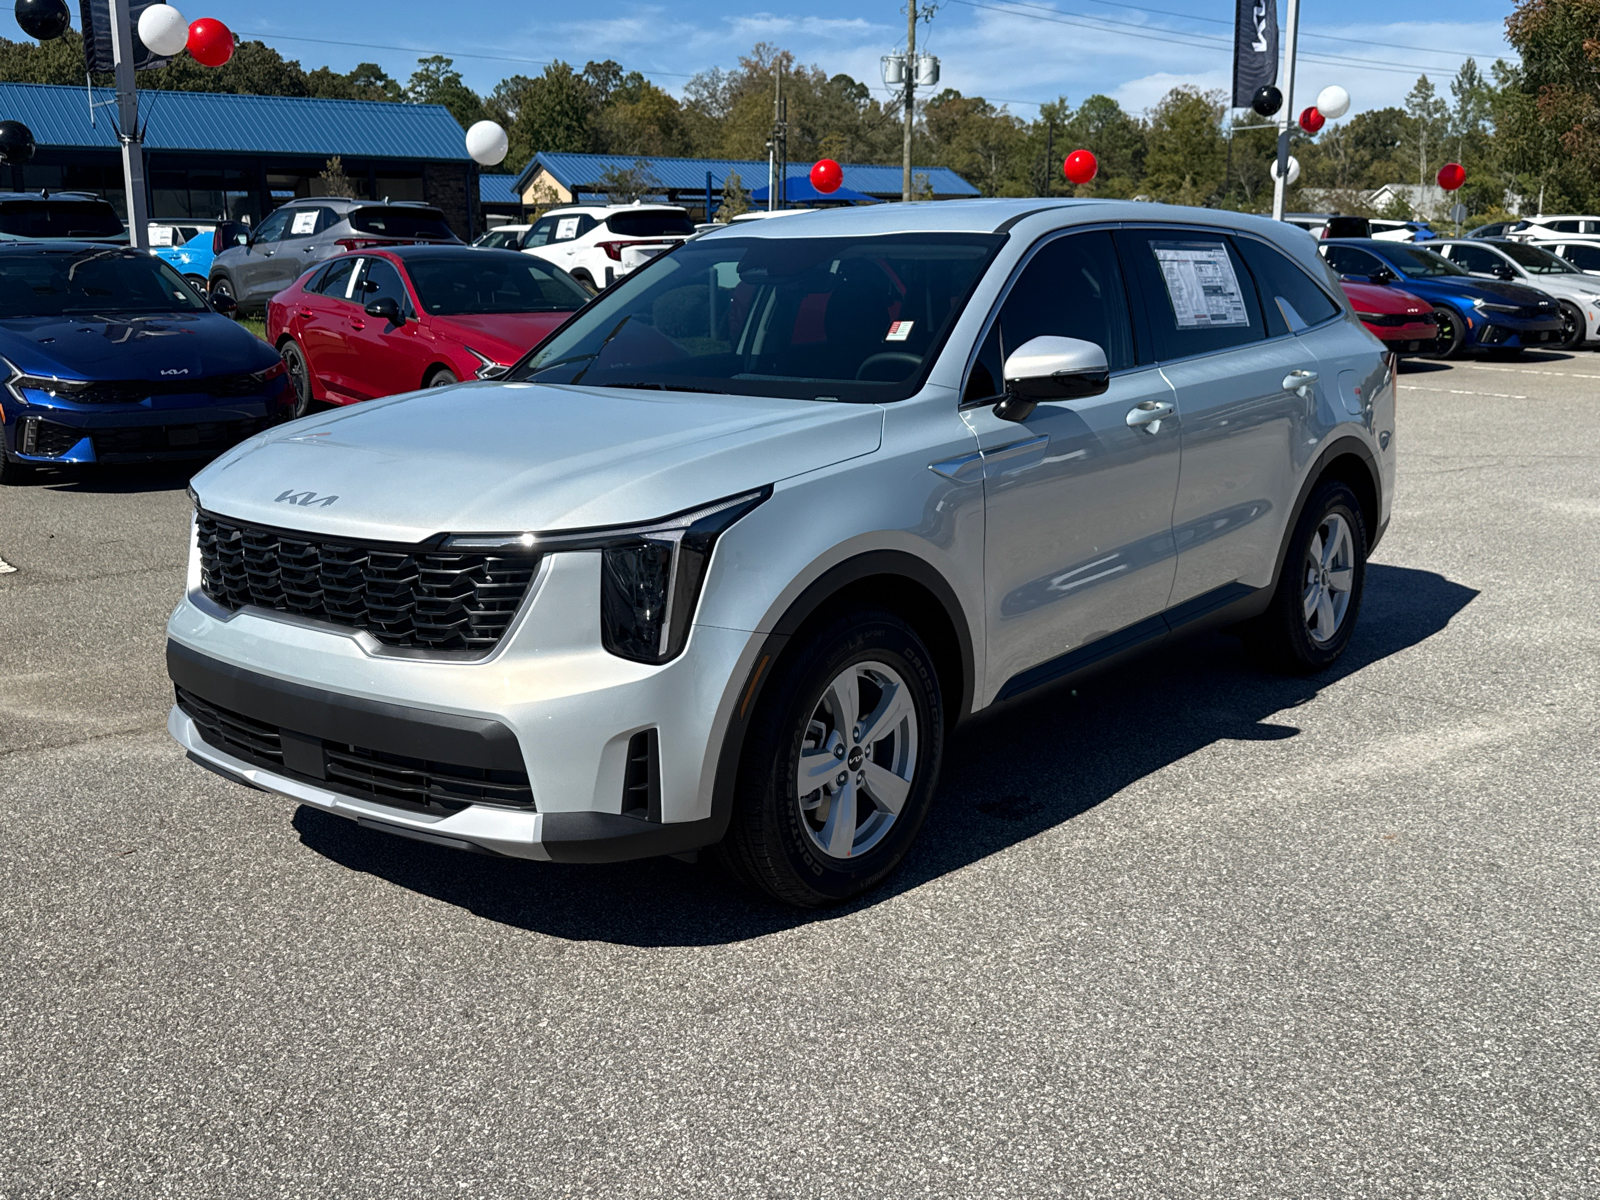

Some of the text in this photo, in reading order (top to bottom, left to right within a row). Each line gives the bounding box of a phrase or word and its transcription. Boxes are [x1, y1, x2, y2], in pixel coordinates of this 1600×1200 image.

[1252, 0, 1268, 52] KI
[160, 368, 189, 376] KIA
[274, 489, 340, 507] KIA
[864, 629, 886, 639] SPORT
[786, 711, 824, 877] CONTINENTAL
